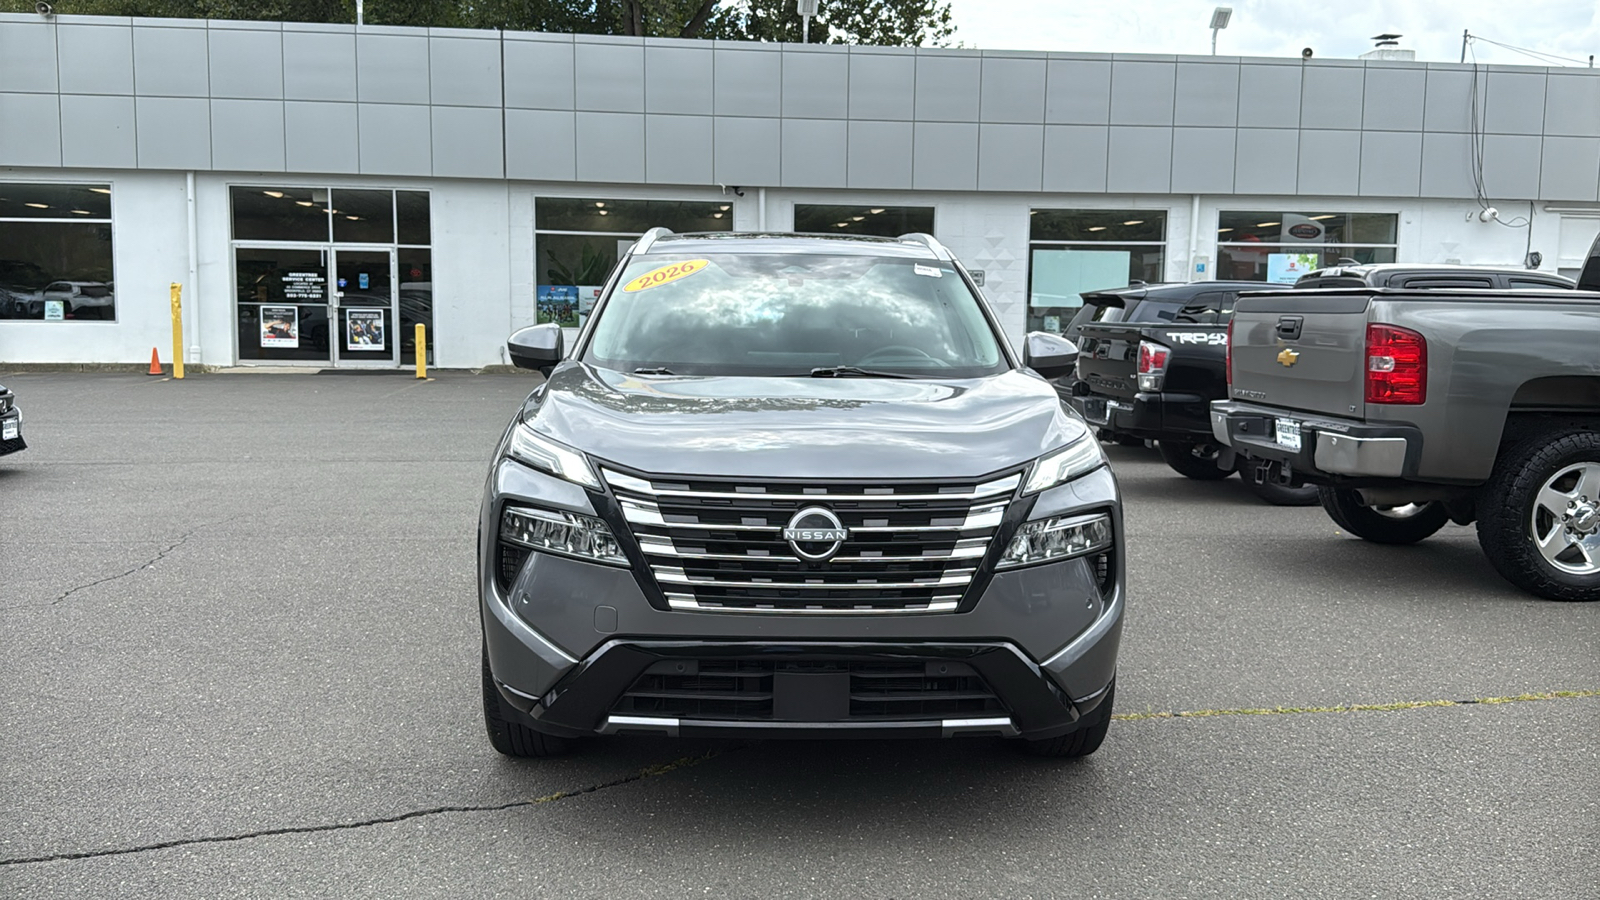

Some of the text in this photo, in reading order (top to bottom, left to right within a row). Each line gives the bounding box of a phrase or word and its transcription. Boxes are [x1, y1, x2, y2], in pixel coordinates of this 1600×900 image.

[638, 261, 694, 289] 2026
[1277, 423, 1301, 436] GREENTREE
[785, 531, 846, 540] NISSAN
